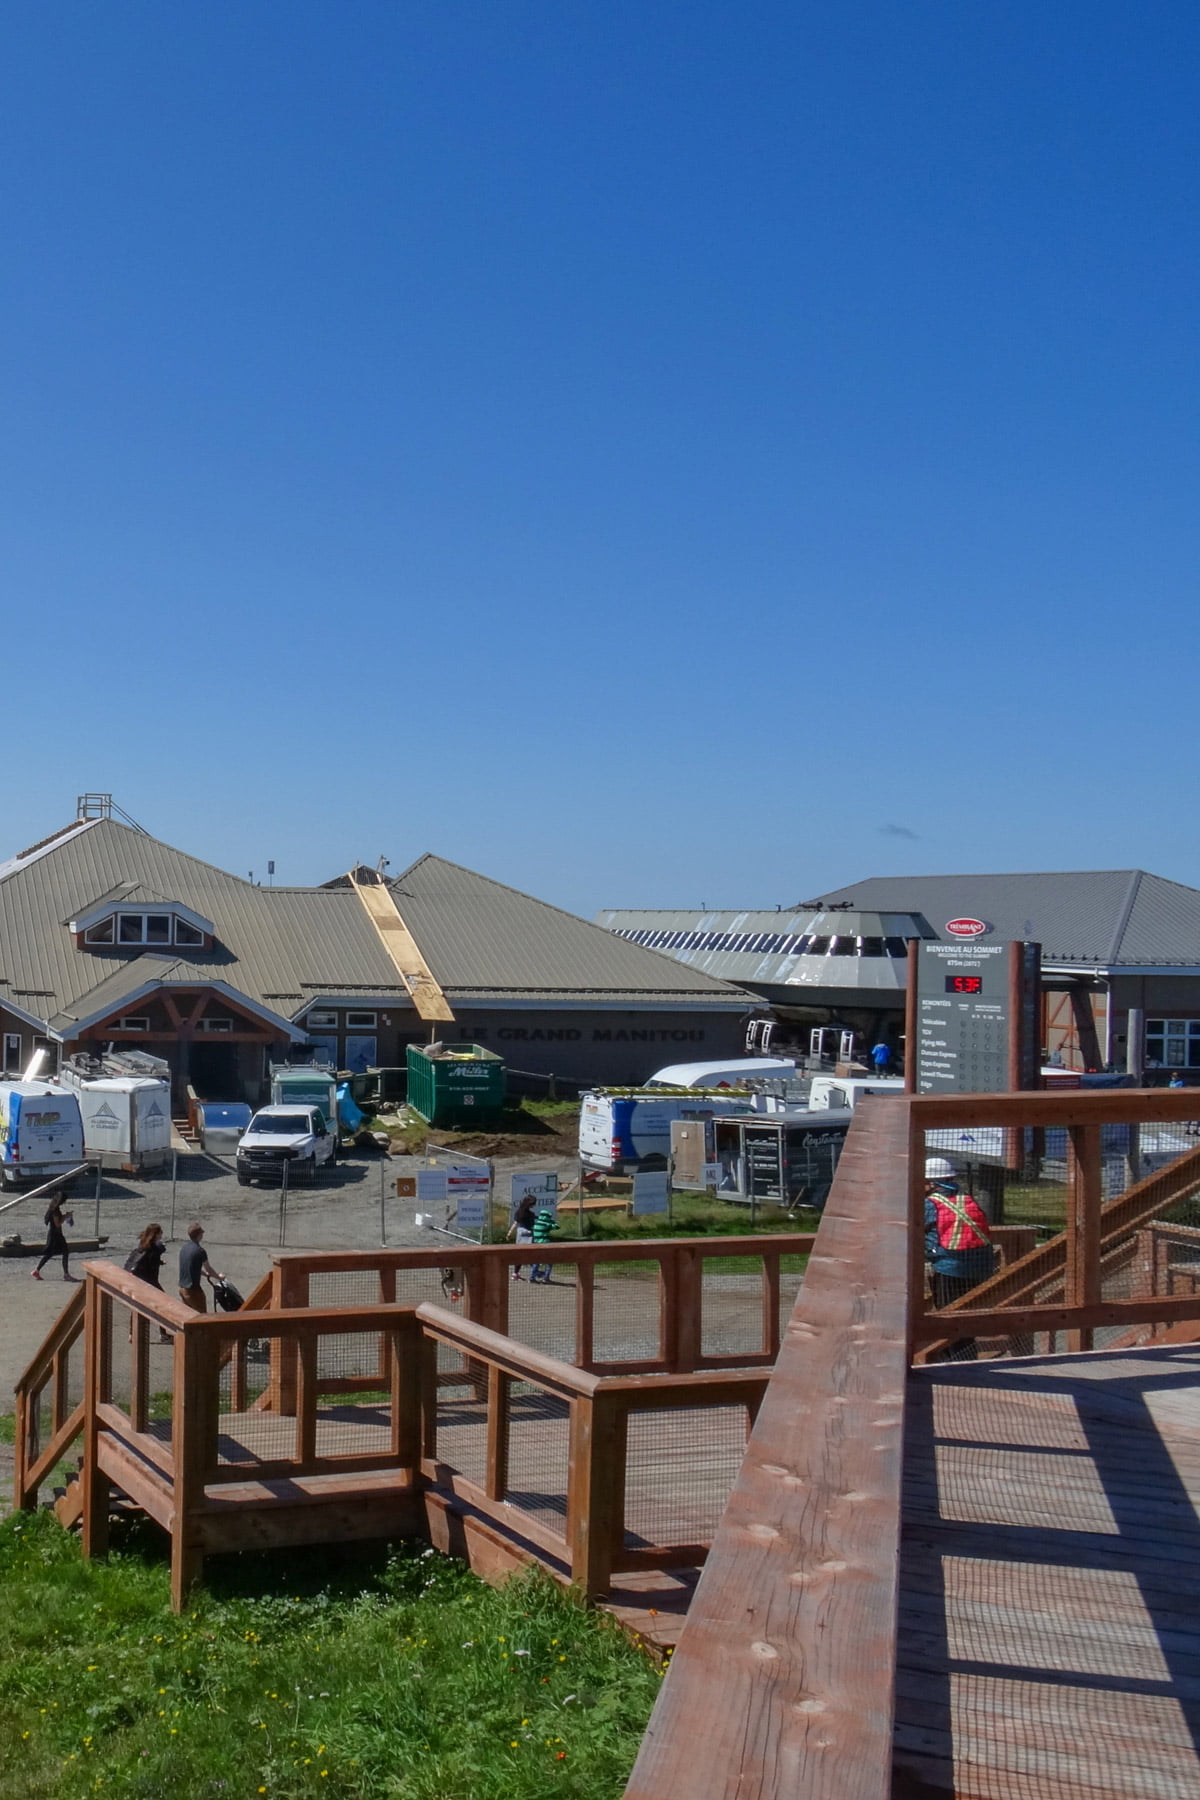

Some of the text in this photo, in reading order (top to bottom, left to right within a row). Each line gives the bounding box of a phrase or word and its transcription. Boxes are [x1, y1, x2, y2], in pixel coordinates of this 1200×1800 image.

[926, 945, 962, 953] BIENVENUE
[973, 946, 1002, 954] SOMMET
[459, 1028, 704, 1042] LE GRAND MANITOU
[24, 1111, 61, 1128] TMP
